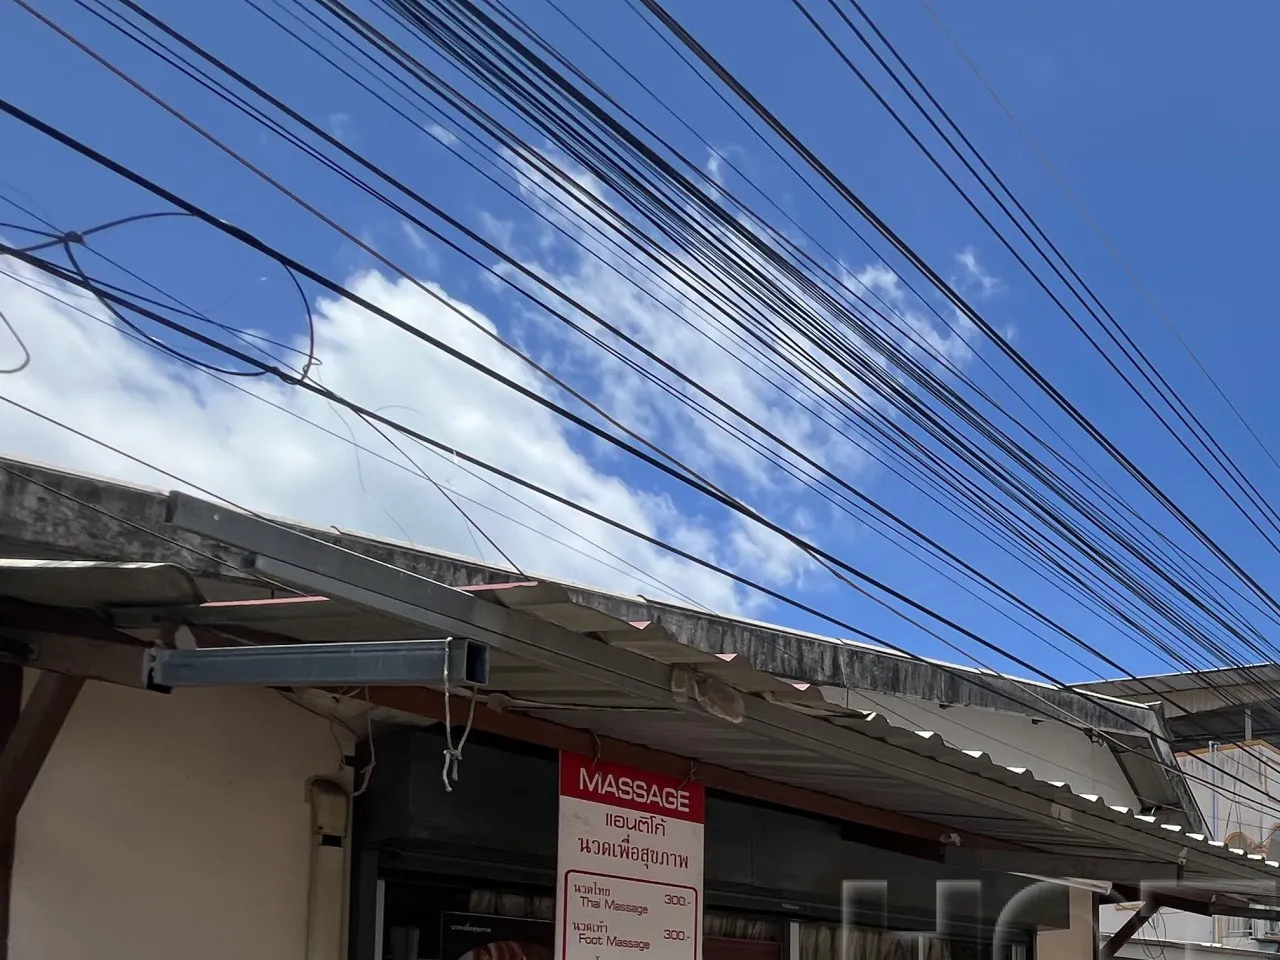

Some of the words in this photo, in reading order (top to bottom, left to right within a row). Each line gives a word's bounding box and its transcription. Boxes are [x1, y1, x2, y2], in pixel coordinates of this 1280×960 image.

[579, 767, 690, 813] MASSAGE
[578, 834, 688, 869] นวดเพื่อสุขภาพ
[573, 882, 611, 897] นวดไทย
[580, 896, 601, 909] Thai
[604, 899, 648, 915] Massage
[572, 920, 608, 933] นวดเท้า
[578, 933, 603, 945] Foot
[606, 936, 650, 951] Massage
